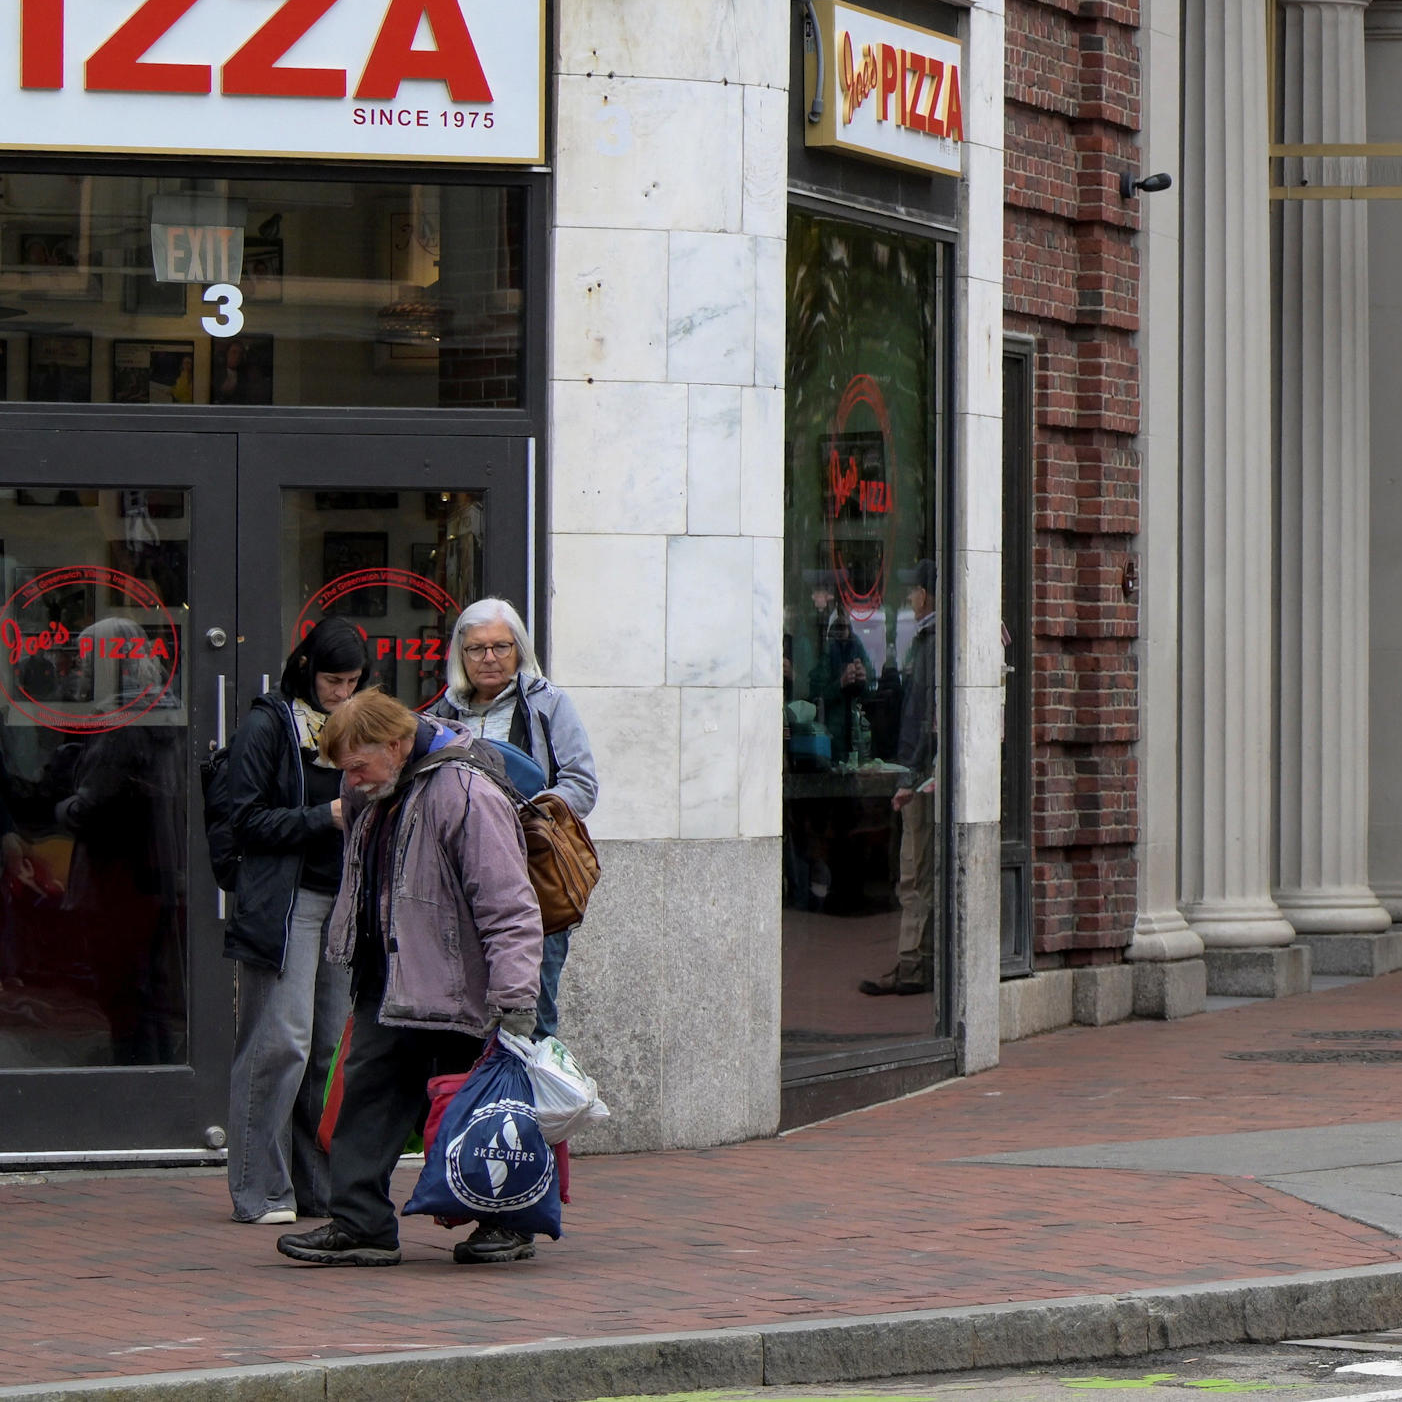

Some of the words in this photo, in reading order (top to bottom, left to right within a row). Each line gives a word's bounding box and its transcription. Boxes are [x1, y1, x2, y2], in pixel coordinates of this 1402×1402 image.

[838, 30, 877, 125] Joe's
[876, 43, 963, 142] PIZZA
[353, 108, 429, 127] SINCE
[440, 111, 494, 129] 1975
[168, 227, 233, 281] EXIT
[201, 284, 244, 337] 3
[859, 480, 893, 513] PIZZA
[1, 618, 69, 664] Joe's
[79, 637, 169, 659] PIZZA
[376, 638, 450, 660] PIZZ
[473, 1147, 536, 1162] SKECHERS
